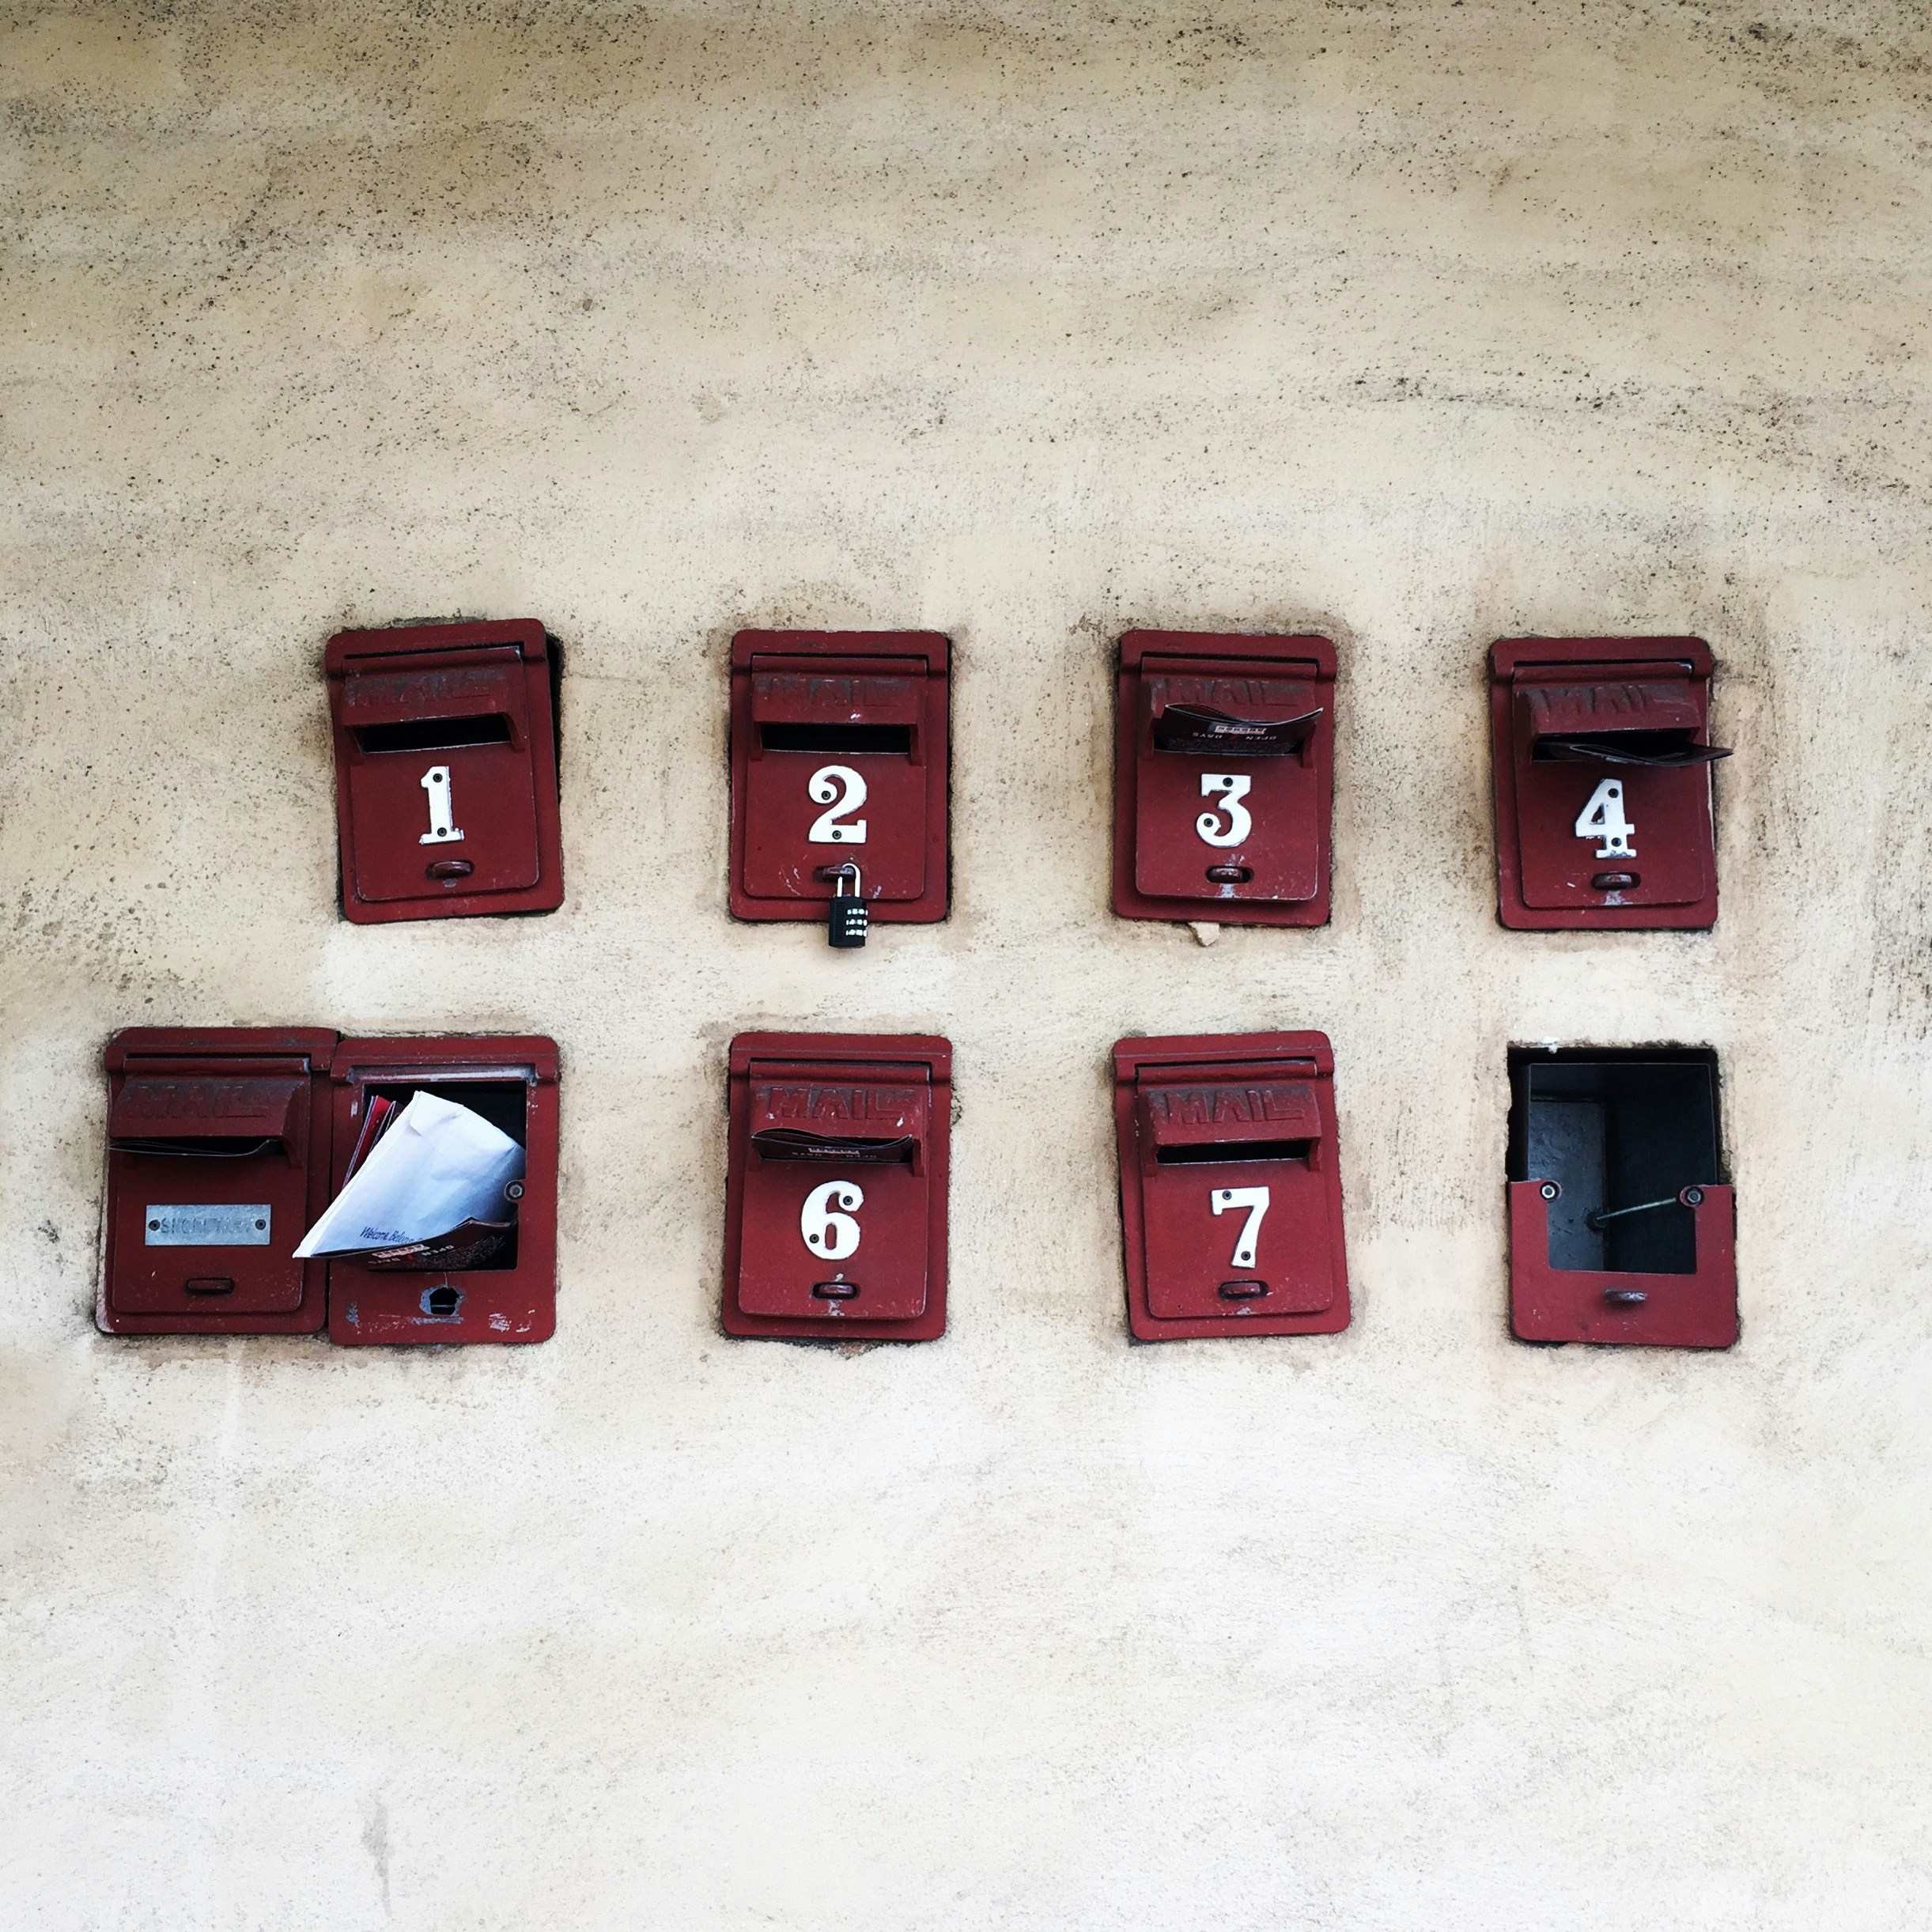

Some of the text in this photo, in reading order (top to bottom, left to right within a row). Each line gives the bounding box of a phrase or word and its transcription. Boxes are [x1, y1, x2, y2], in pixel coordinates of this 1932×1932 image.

[419, 766, 464, 845] 1
[809, 766, 867, 843] 2
[1197, 774, 1252, 847] 3
[1575, 779, 1636, 858] 4
[768, 1086, 909, 1120] MAIL
[1164, 1089, 1305, 1124] MAIL
[801, 1181, 864, 1260] 6
[1212, 1186, 1269, 1268] 7
